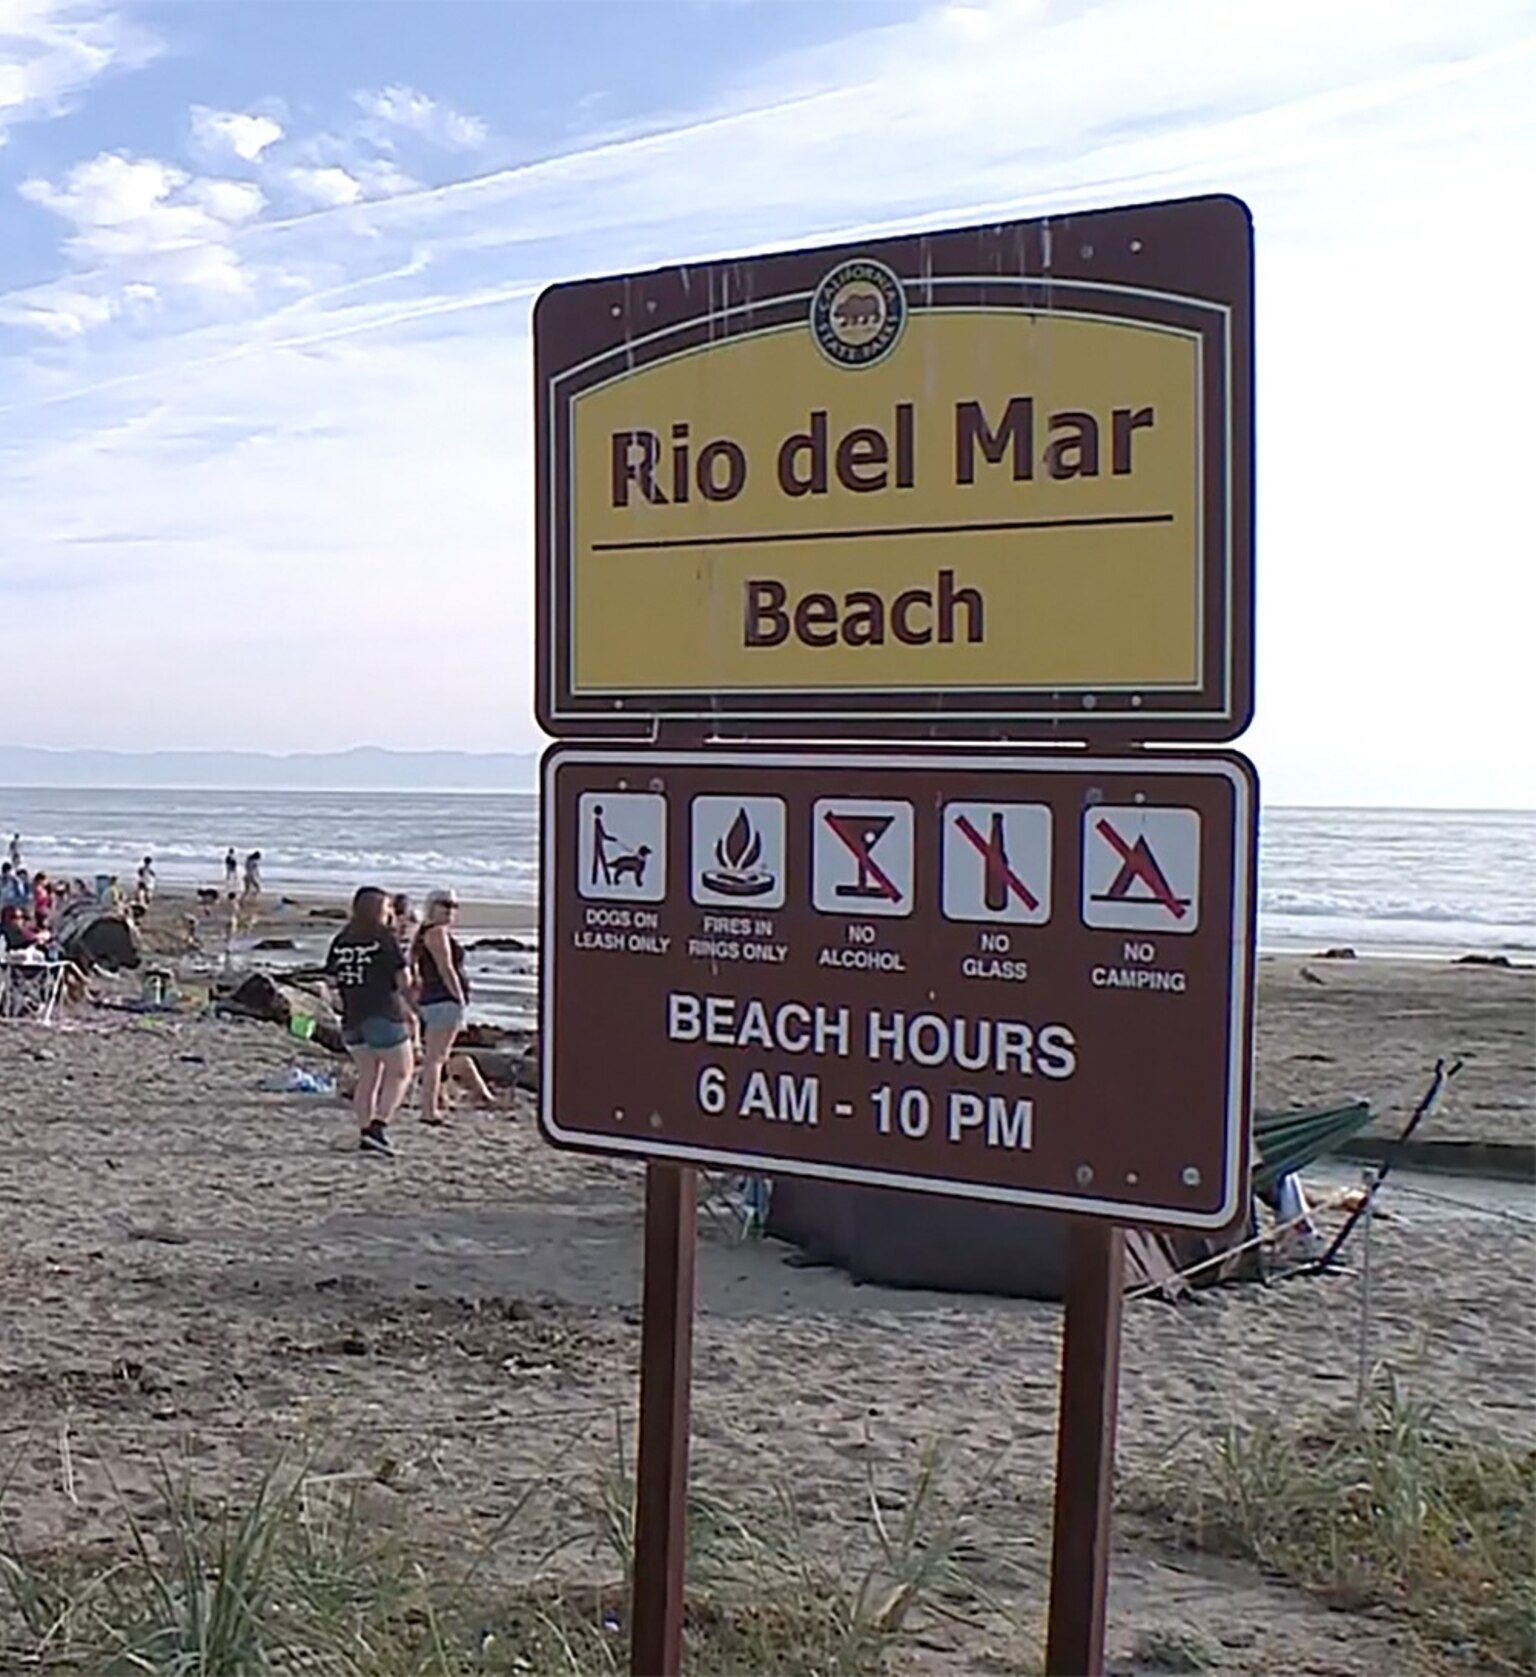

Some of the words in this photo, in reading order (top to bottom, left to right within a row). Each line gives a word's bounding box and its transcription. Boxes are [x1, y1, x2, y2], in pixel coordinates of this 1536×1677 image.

[611, 422, 746, 508] Rio
[777, 404, 914, 497] del
[955, 396, 1153, 486] Mar
[744, 570, 984, 648] Beach
[585, 909, 630, 927] DOGS
[633, 912, 658, 929] ON
[704, 916, 751, 935] FIRES
[755, 919, 773, 936] IN
[574, 931, 625, 950] LEASH
[628, 935, 671, 953] ONLY
[848, 925, 876, 943] NO
[980, 934, 1010, 952] NO
[688, 939, 740, 959] RINGS
[743, 943, 788, 961] ONLY
[819, 950, 906, 972] ALCOHOL
[1124, 943, 1154, 962] NO
[962, 959, 1027, 980] GLASS
[1091, 968, 1186, 991] CAMPING
[668, 993, 849, 1056] BEACH
[868, 1010, 1077, 1078] HOURS
[698, 1067, 726, 1114] 6
[739, 1071, 819, 1125] AM
[835, 1102, 853, 1115] -
[871, 1086, 931, 1138] 10
[949, 1093, 1033, 1150] PM
